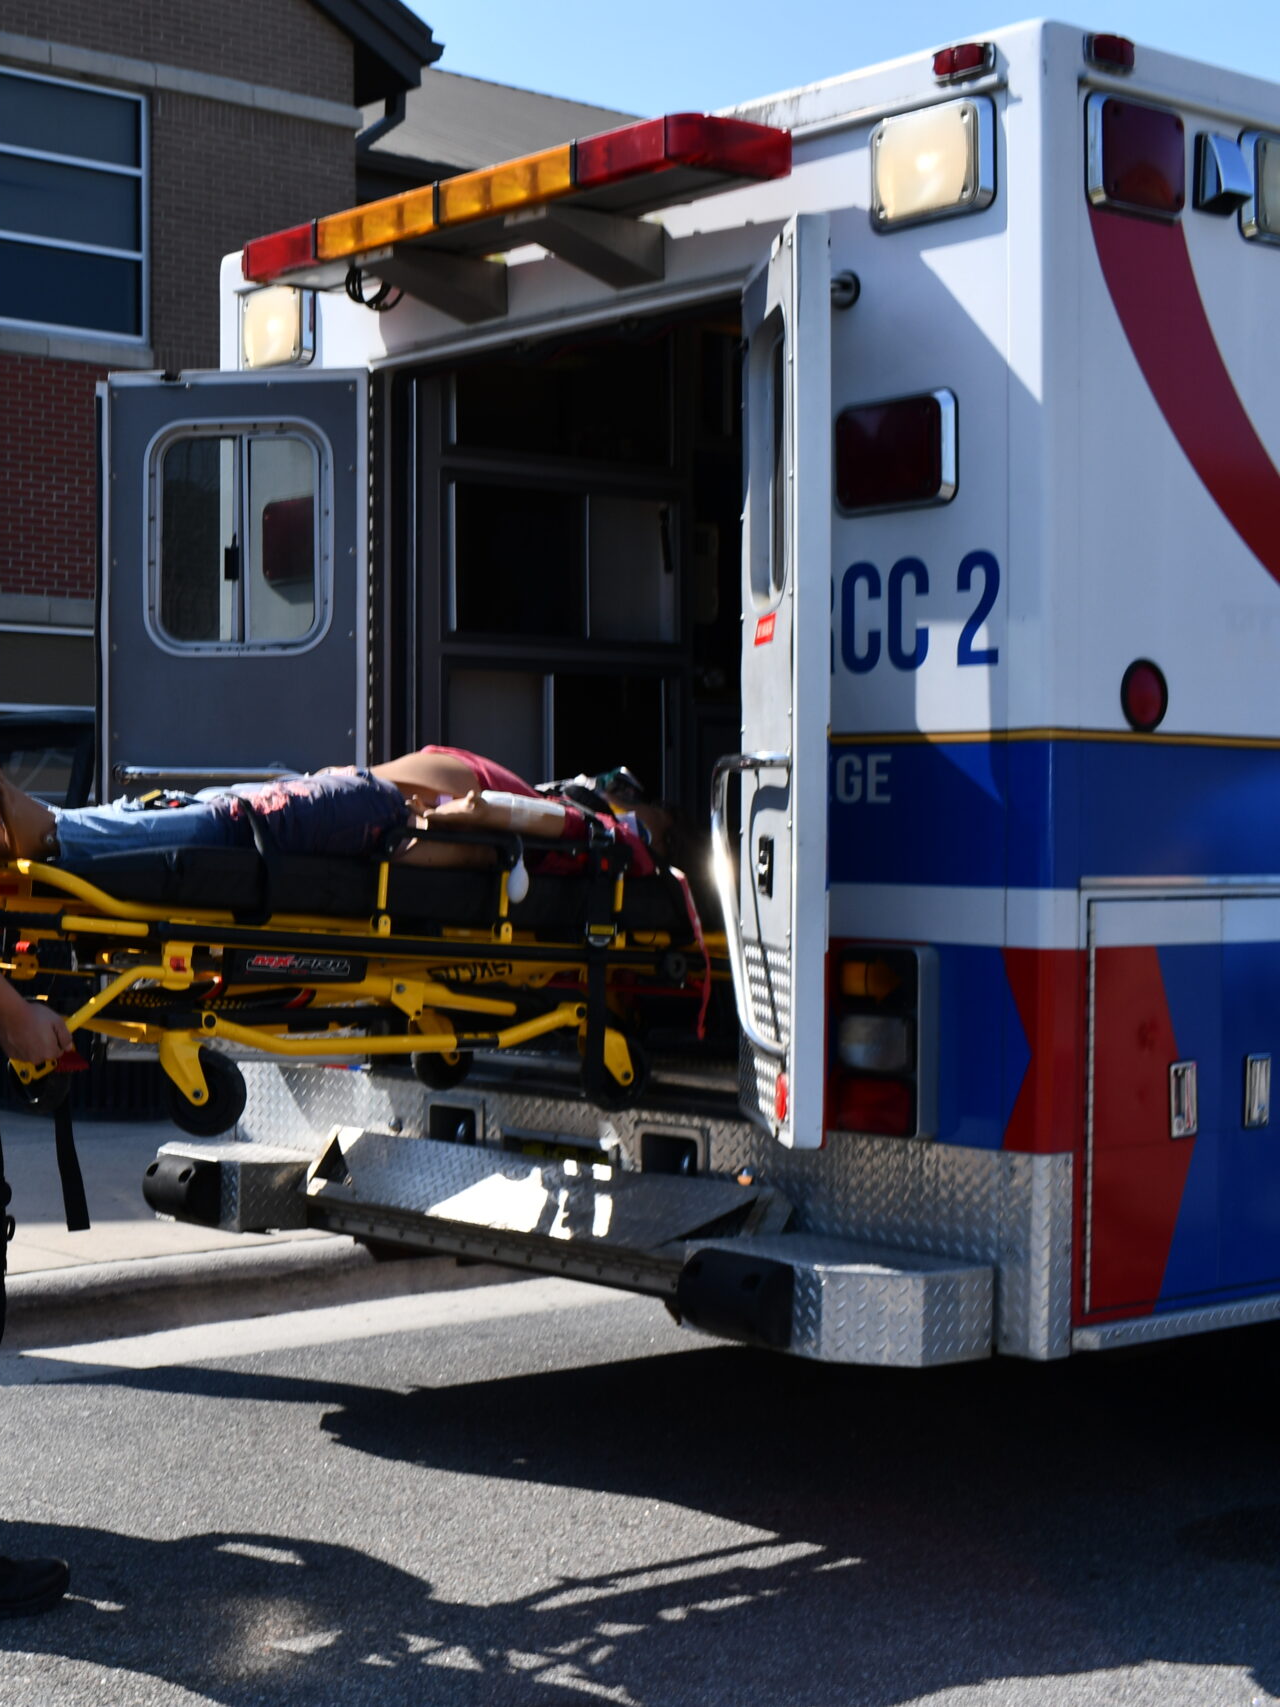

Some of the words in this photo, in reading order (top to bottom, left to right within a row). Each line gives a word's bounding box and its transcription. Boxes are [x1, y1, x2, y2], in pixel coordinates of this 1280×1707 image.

[830, 556, 930, 674] CC
[955, 549, 1001, 667] 2
[830, 753, 892, 804] GE
